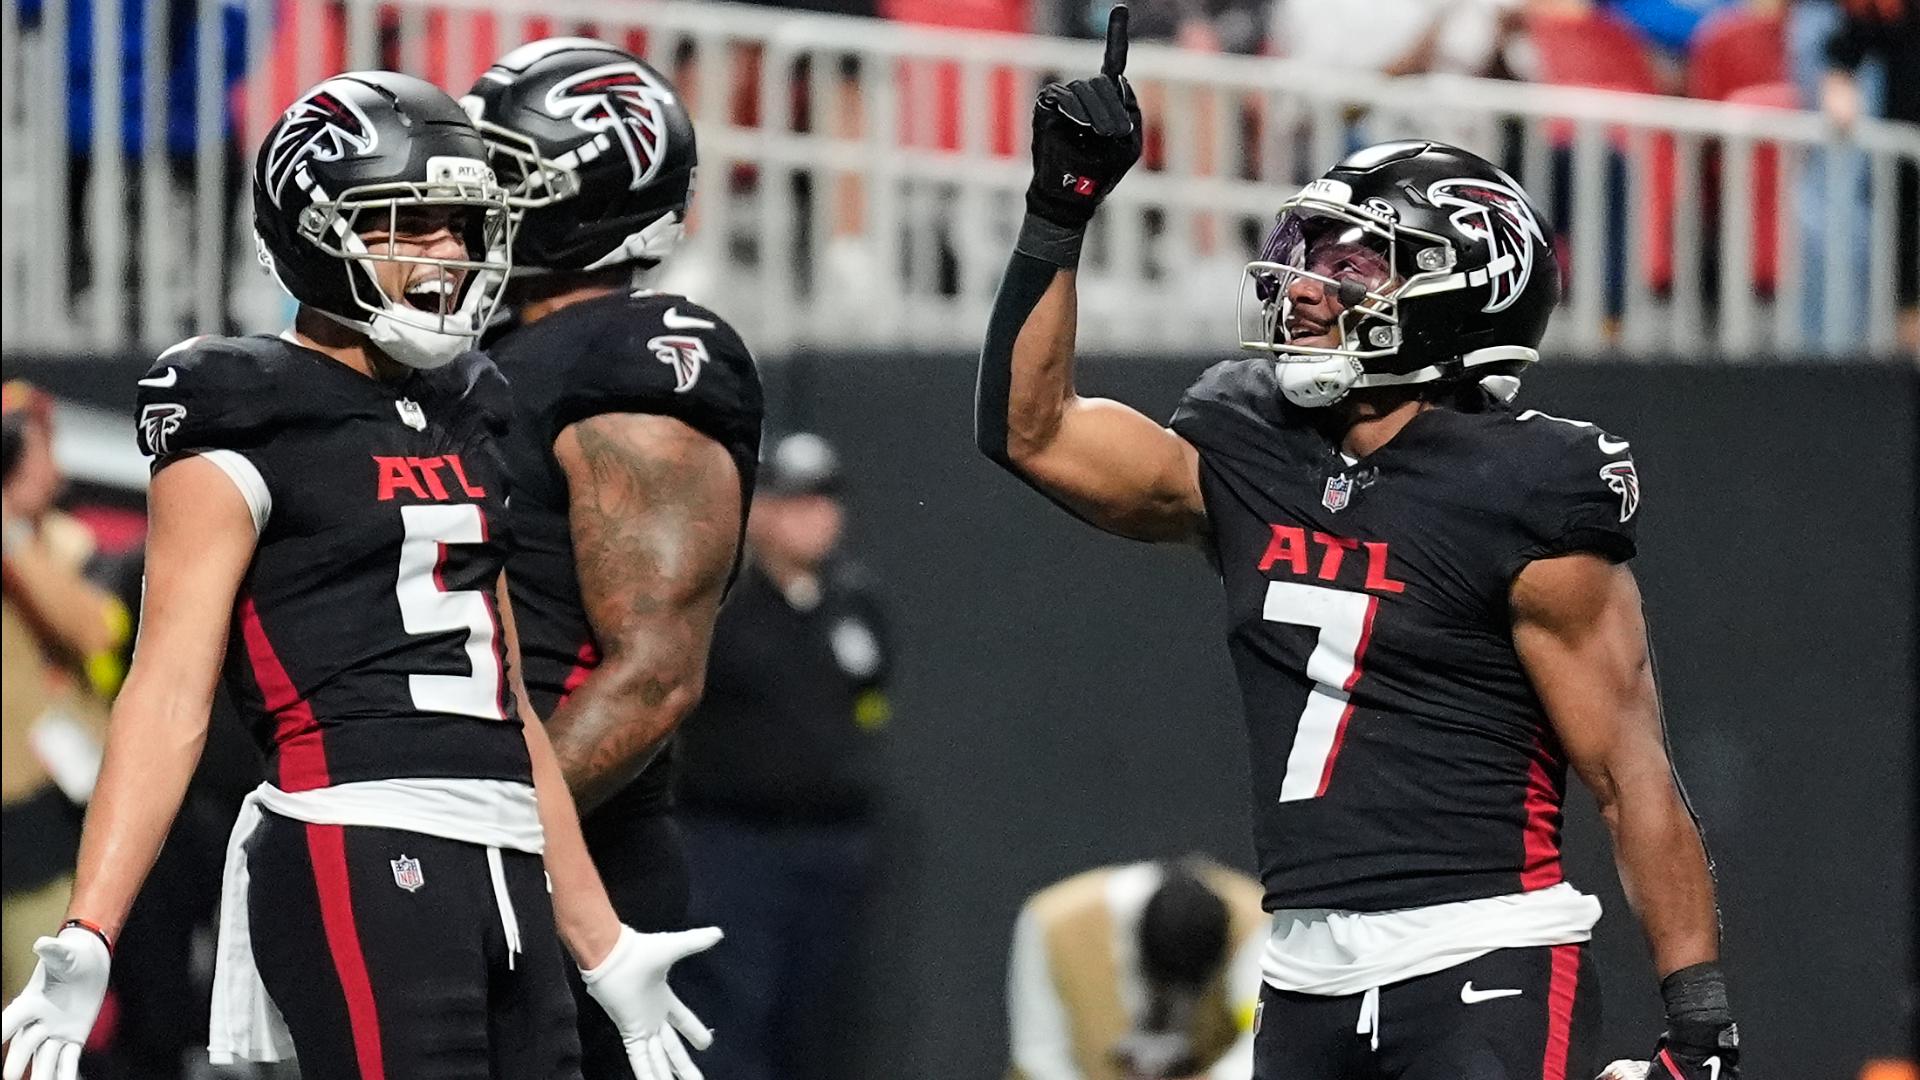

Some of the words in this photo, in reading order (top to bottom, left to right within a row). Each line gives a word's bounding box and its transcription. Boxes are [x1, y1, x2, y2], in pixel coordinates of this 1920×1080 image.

[1080, 179, 1090, 191] 7
[1309, 181, 1331, 193] ATL
[371, 454, 487, 501] ATL
[1257, 523, 1406, 593] ATL
[396, 504, 507, 721] 5
[1262, 580, 1380, 803] 7
